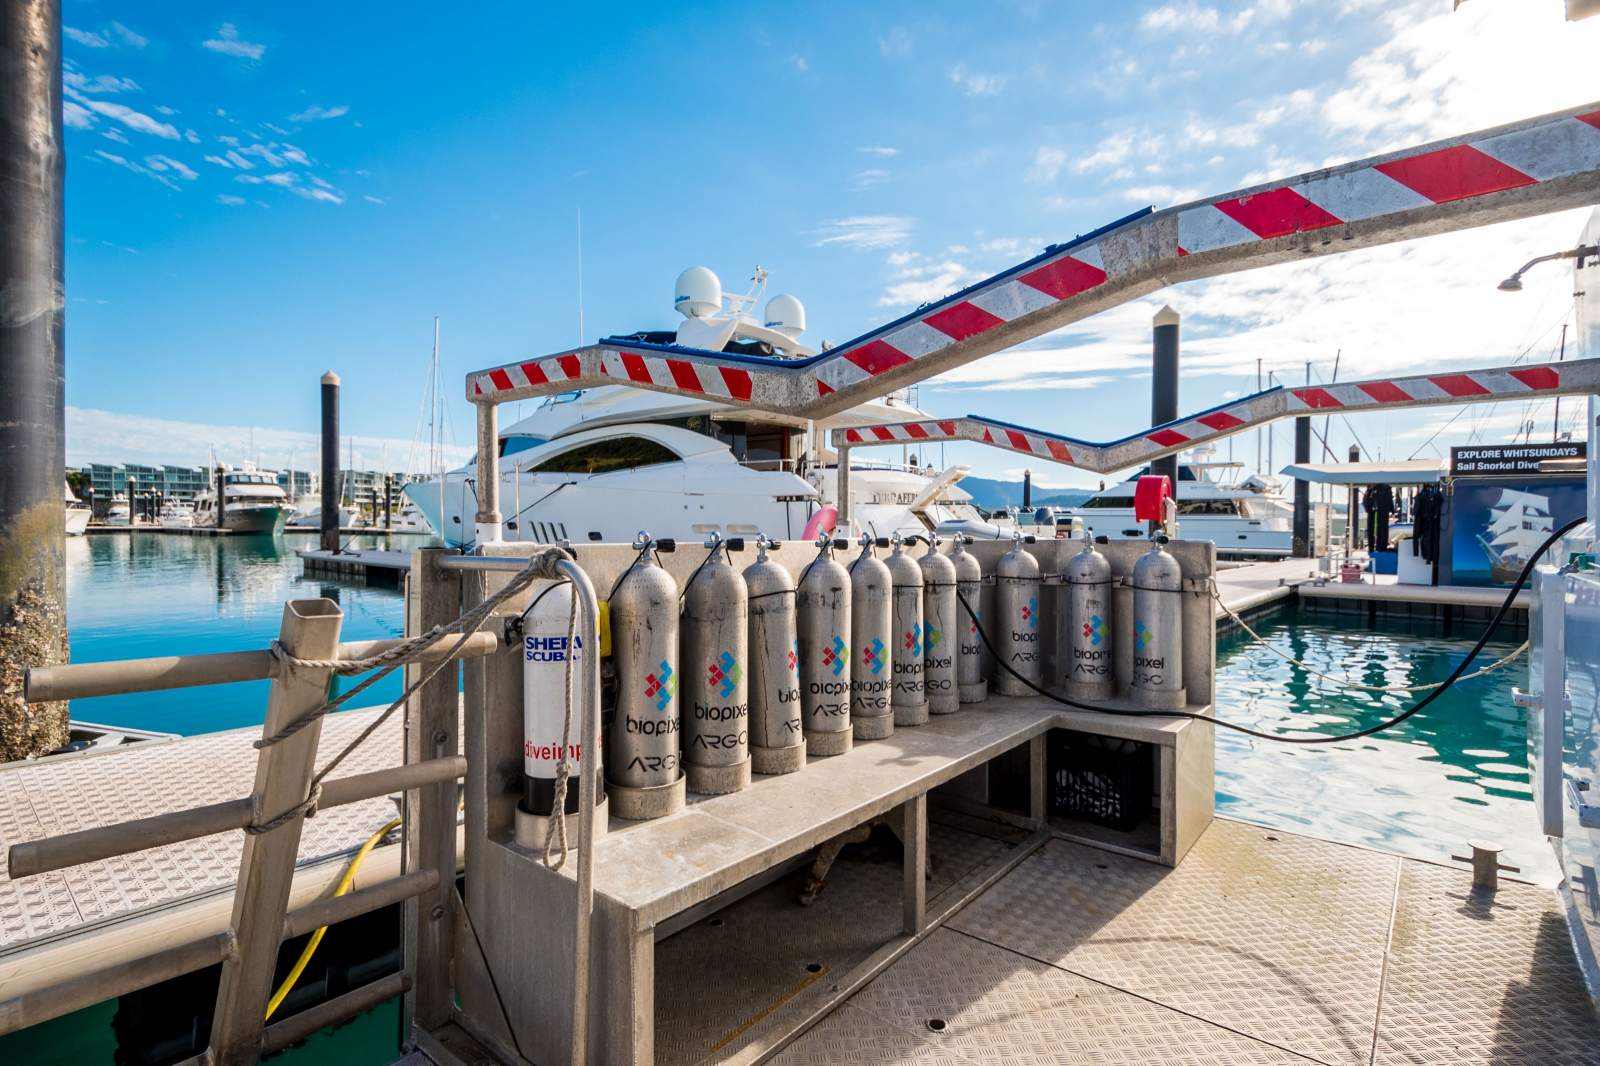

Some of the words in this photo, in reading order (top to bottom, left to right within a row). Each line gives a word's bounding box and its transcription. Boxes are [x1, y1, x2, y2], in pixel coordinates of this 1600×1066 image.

[1457, 450, 1501, 459] EXPLORE
[1503, 448, 1578, 458] WHITSUNDAYS
[1457, 462, 1475, 471] Sail
[1477, 461, 1515, 470] Snorkel
[1517, 460, 1539, 470] Dive
[692, 730, 747, 749] ARGO
